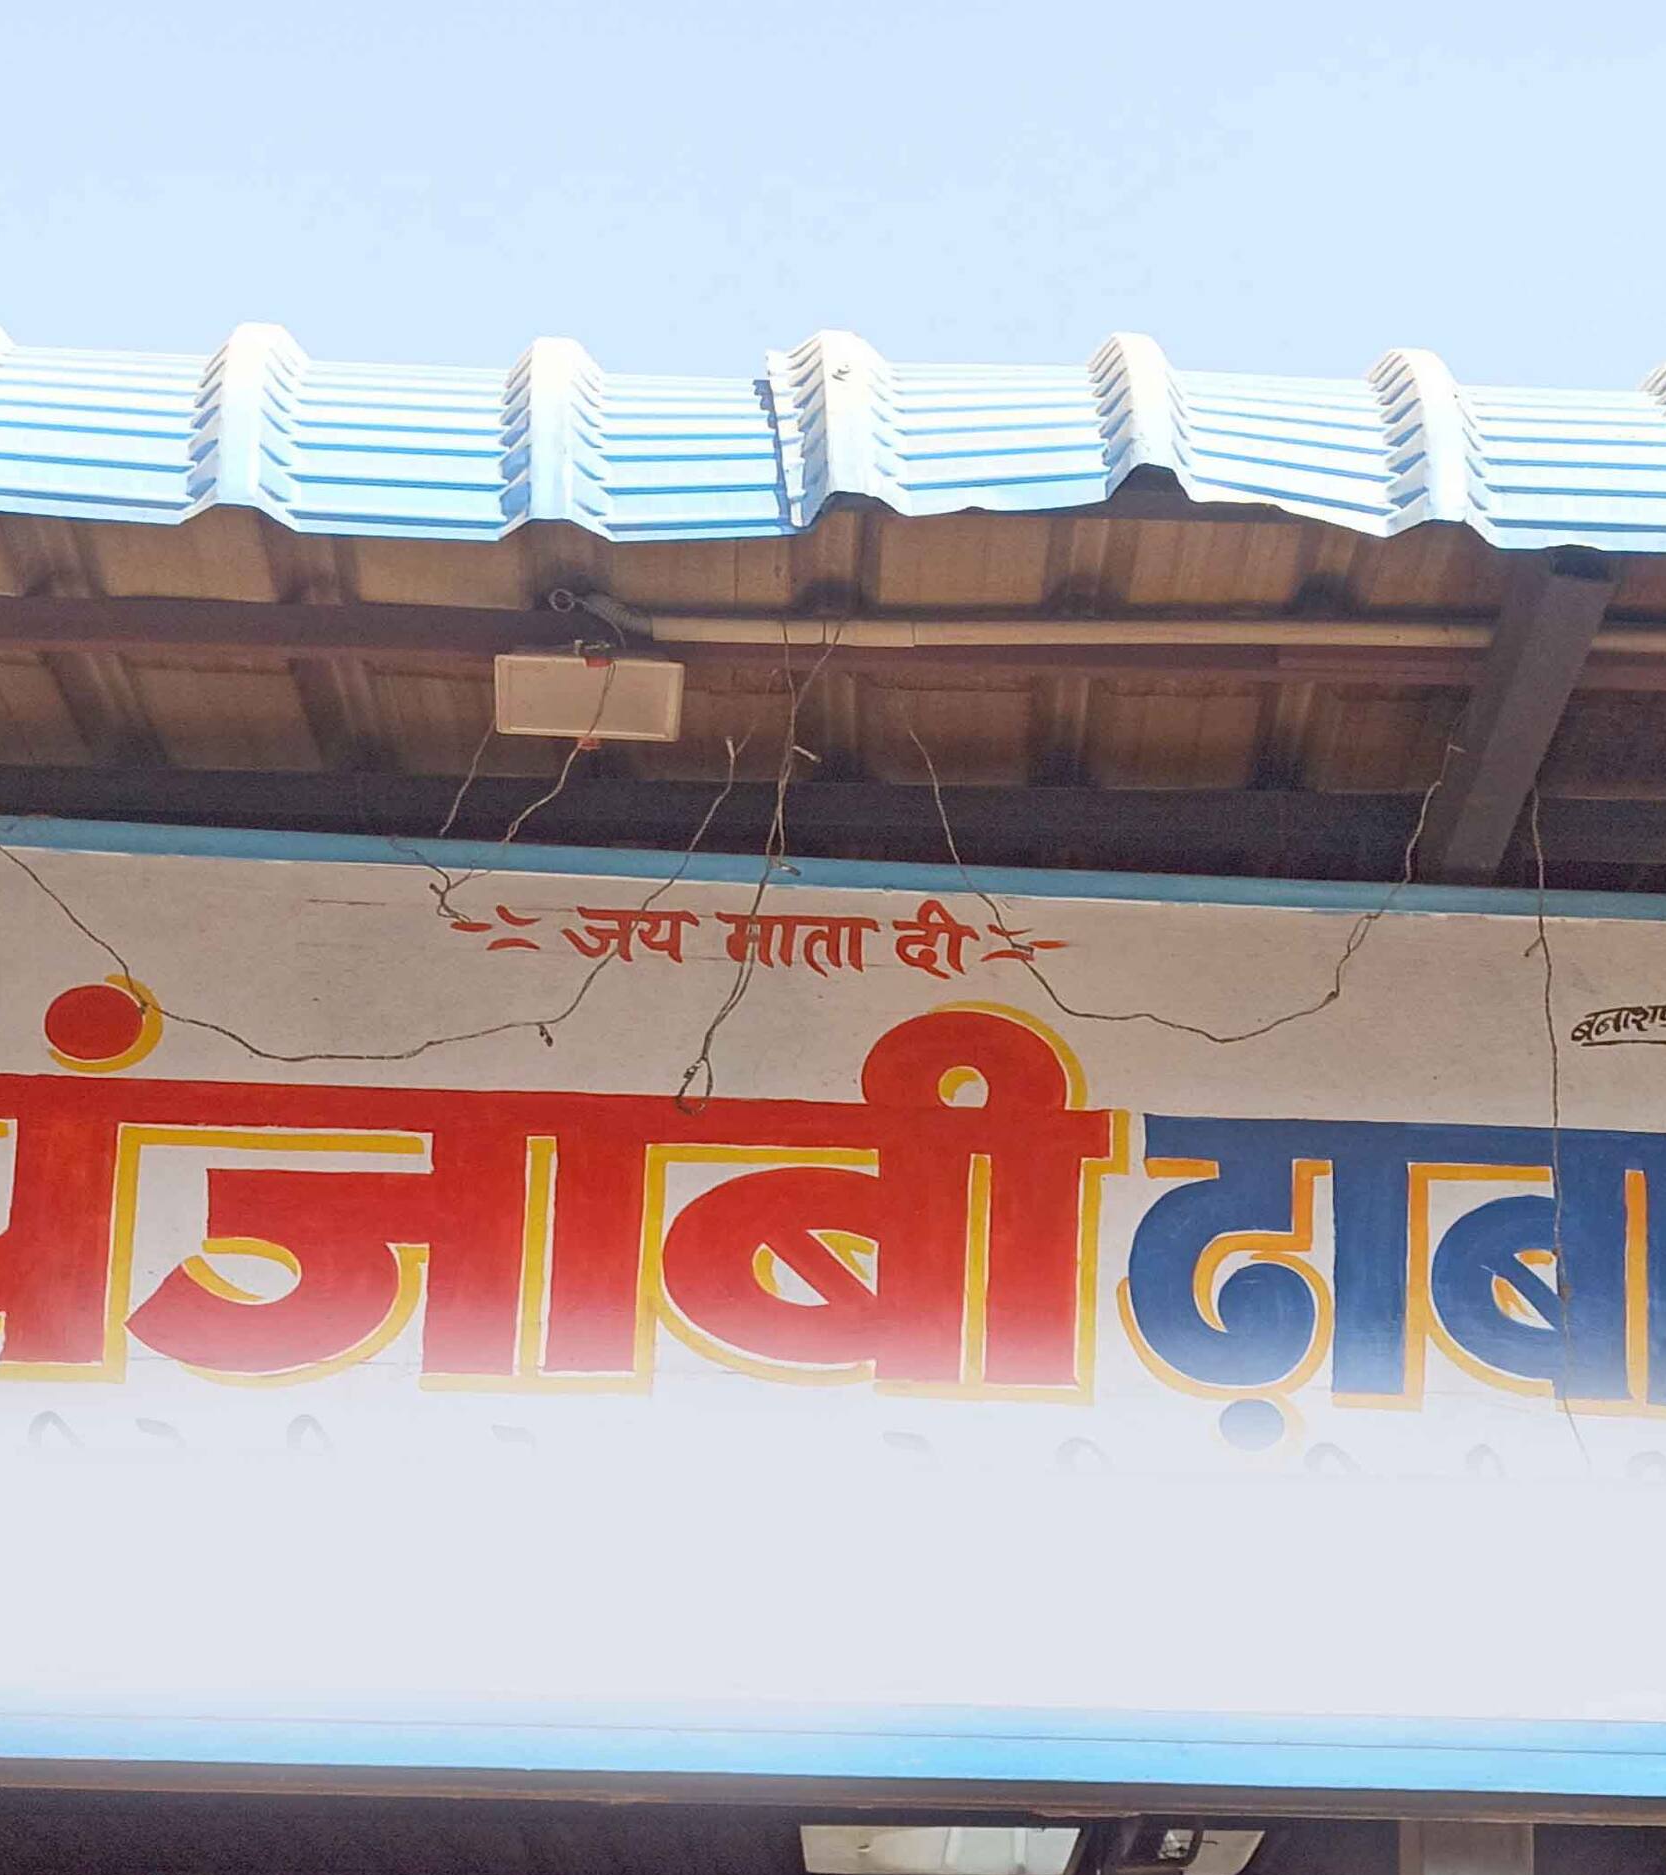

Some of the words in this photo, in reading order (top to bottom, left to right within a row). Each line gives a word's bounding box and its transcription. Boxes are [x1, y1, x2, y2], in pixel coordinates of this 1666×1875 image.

[562, 905, 700, 964] जय
[715, 910, 880, 977] माता
[892, 899, 980, 980] दी
